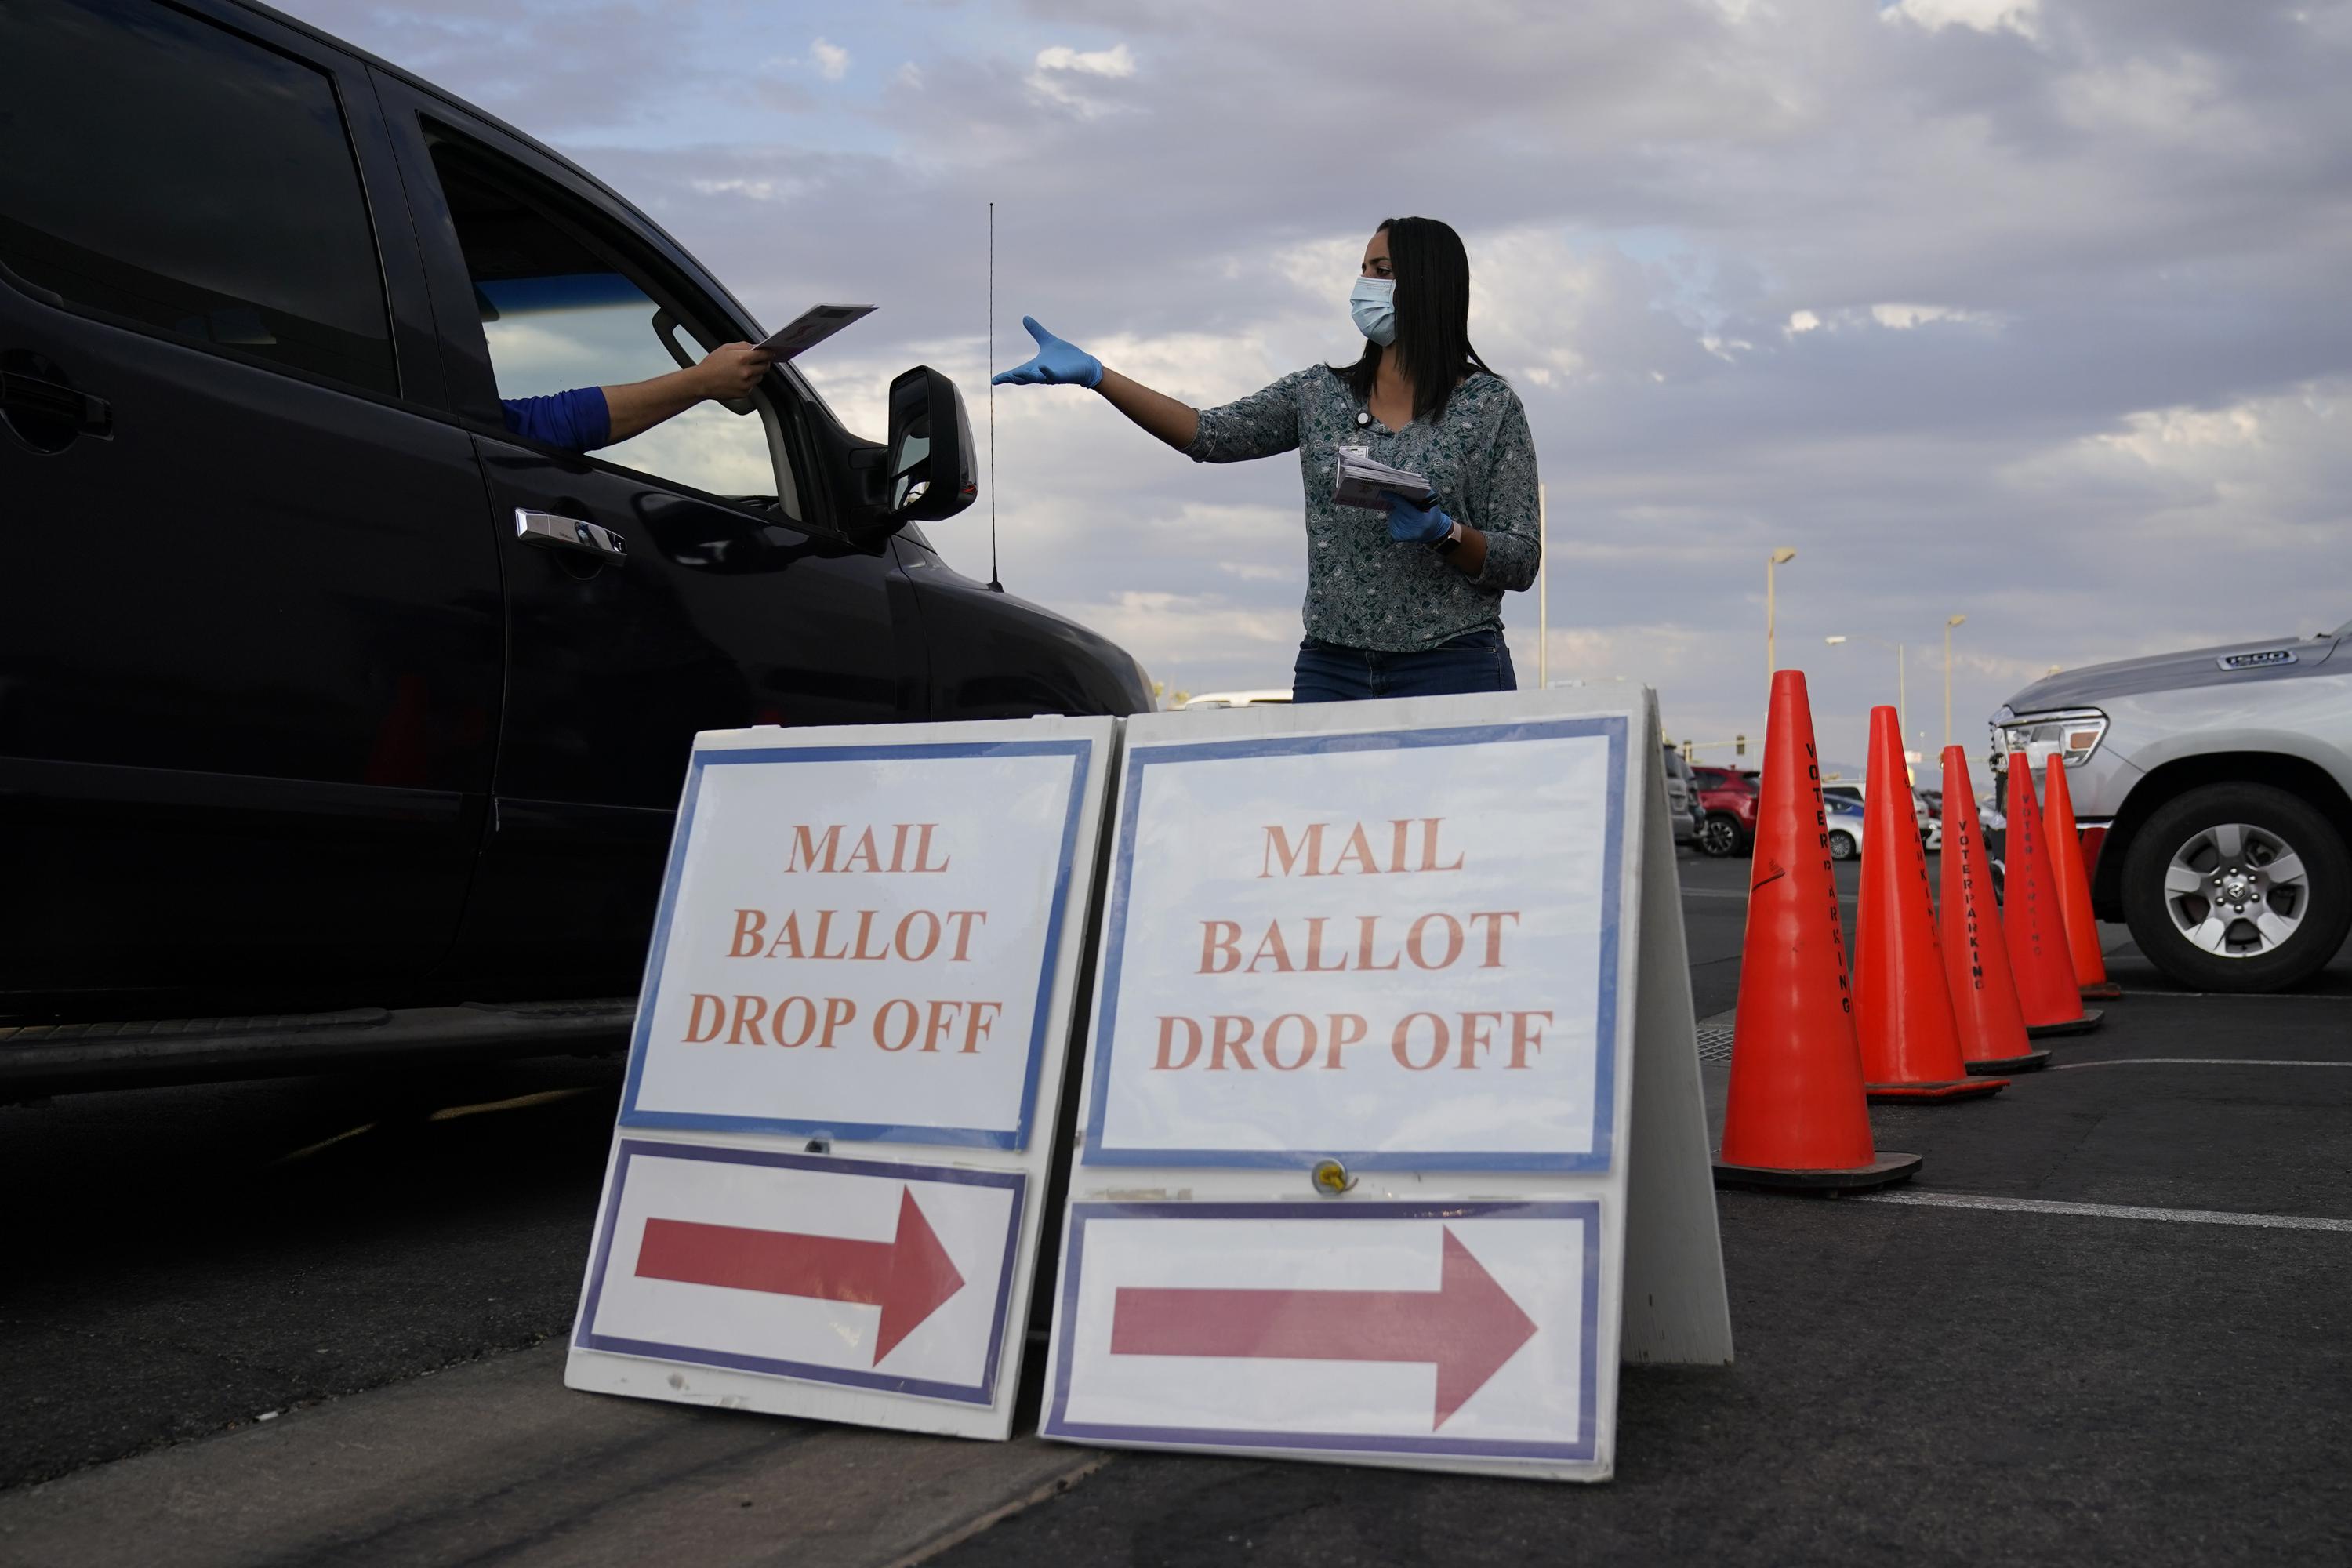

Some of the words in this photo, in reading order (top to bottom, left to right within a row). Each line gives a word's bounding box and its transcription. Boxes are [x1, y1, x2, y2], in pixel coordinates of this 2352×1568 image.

[784, 823, 950, 873] MAIL
[1257, 817, 1465, 879] MAIL
[1806, 743, 1828, 848] VOTER
[1824, 860, 1850, 1013] PARKING
[725, 909, 986, 962] BALLOT
[1194, 910, 1520, 975] BALLOT
[681, 993, 857, 1049] DROP
[872, 999, 1002, 1054] OFF
[1149, 1014, 1368, 1071] DROP
[1391, 1010, 1553, 1071] OFF
